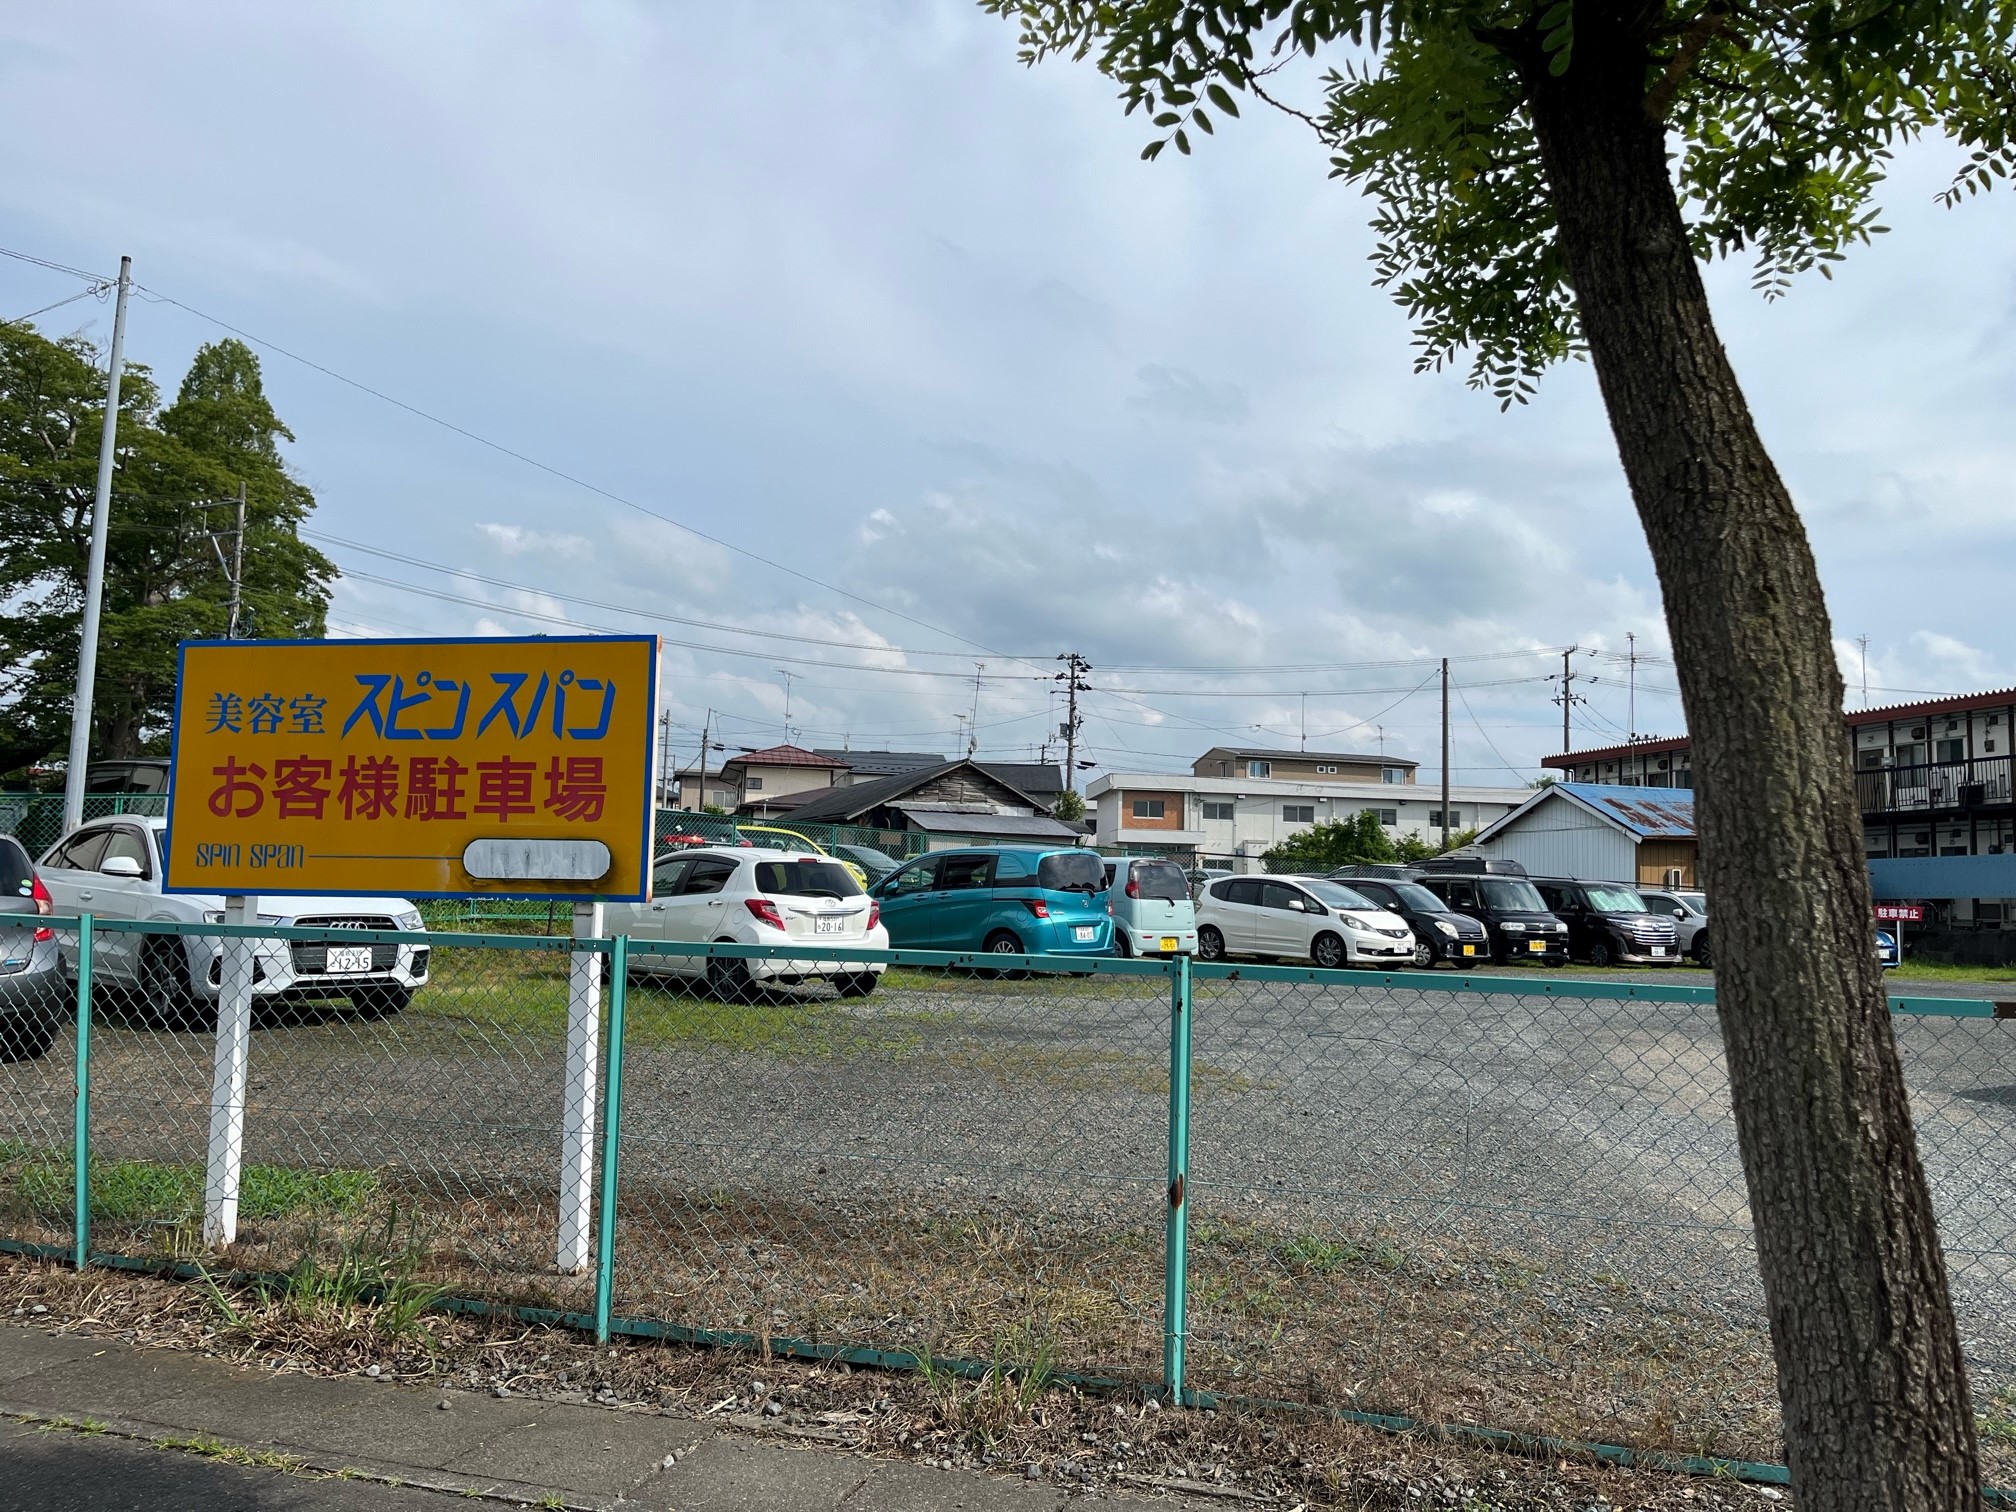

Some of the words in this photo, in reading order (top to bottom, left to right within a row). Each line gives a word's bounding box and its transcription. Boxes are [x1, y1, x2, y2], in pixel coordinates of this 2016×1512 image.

[205, 692, 328, 734] 美容室
[207, 755, 608, 823] お客様駐車場
[821, 922, 842, 931] 20-16
[1877, 908, 1919, 919] 駐車禁止
